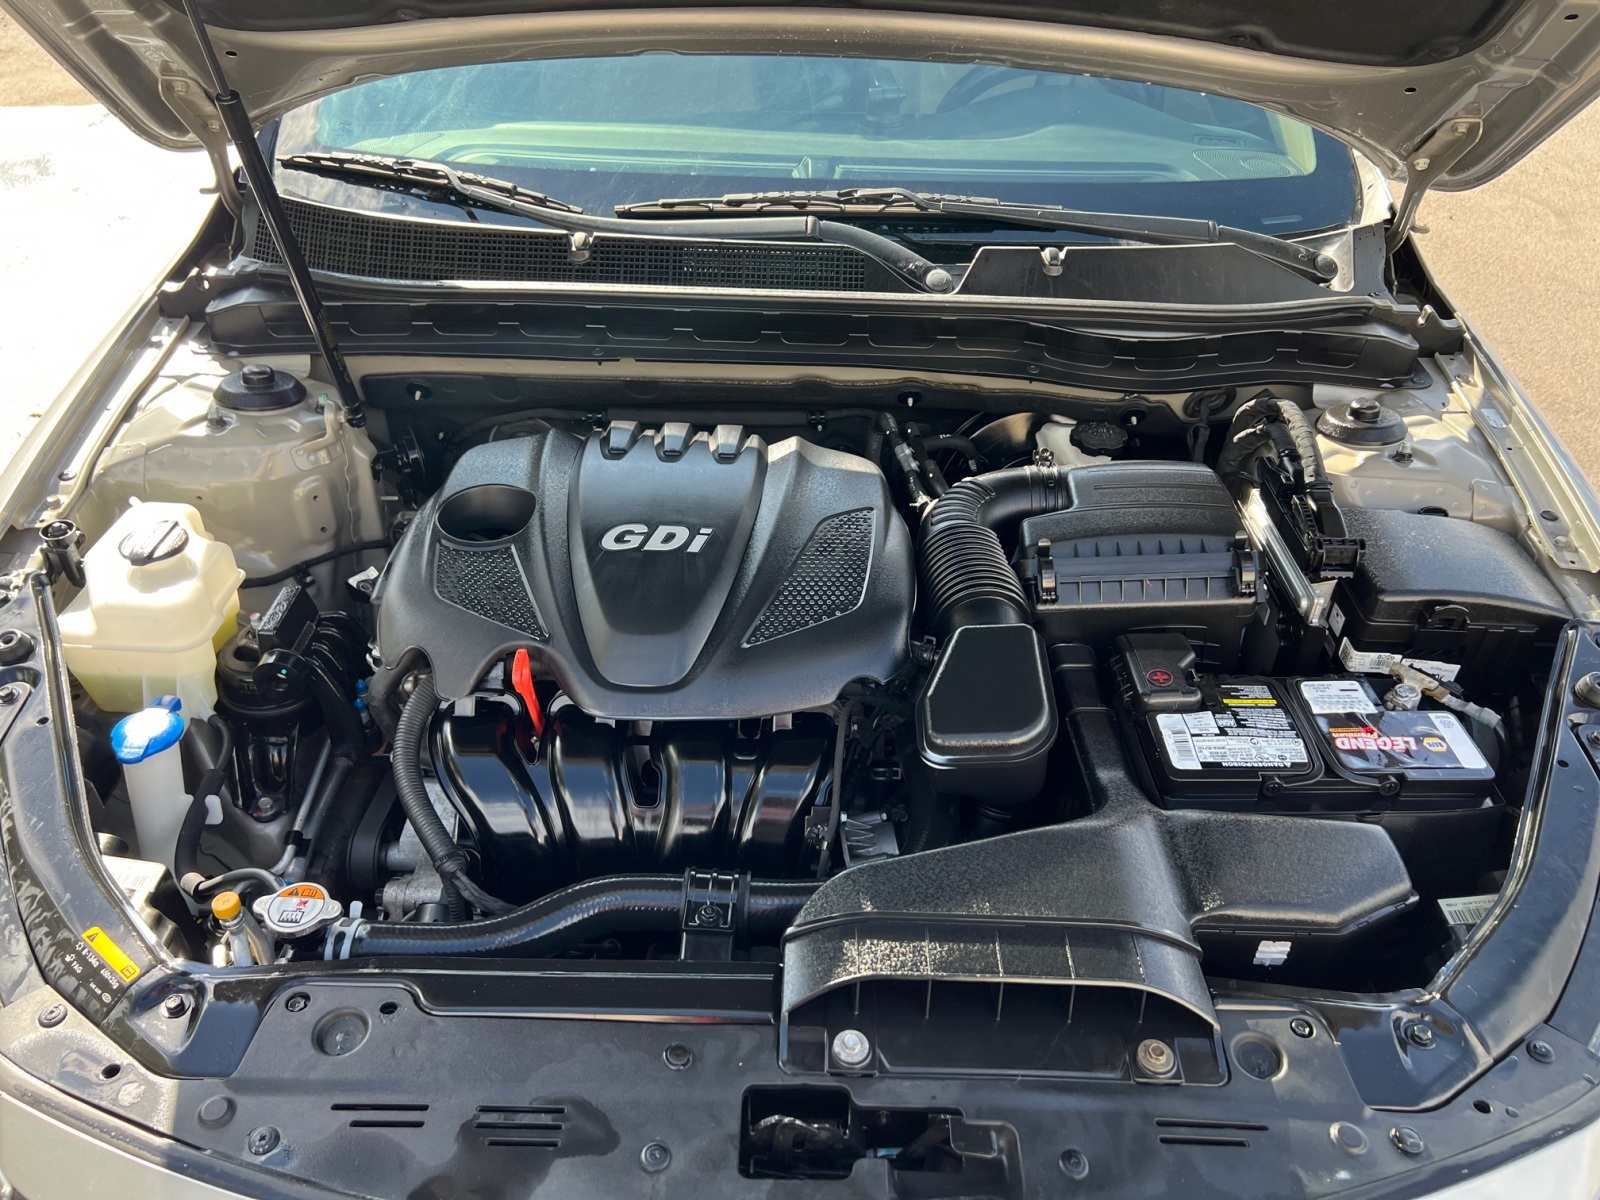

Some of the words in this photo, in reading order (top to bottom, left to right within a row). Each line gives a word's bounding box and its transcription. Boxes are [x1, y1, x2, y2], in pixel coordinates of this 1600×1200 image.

[598, 523, 715, 553] GDi
[1335, 737, 1417, 750] LEGEND
[71, 961, 82, 973] PAG
